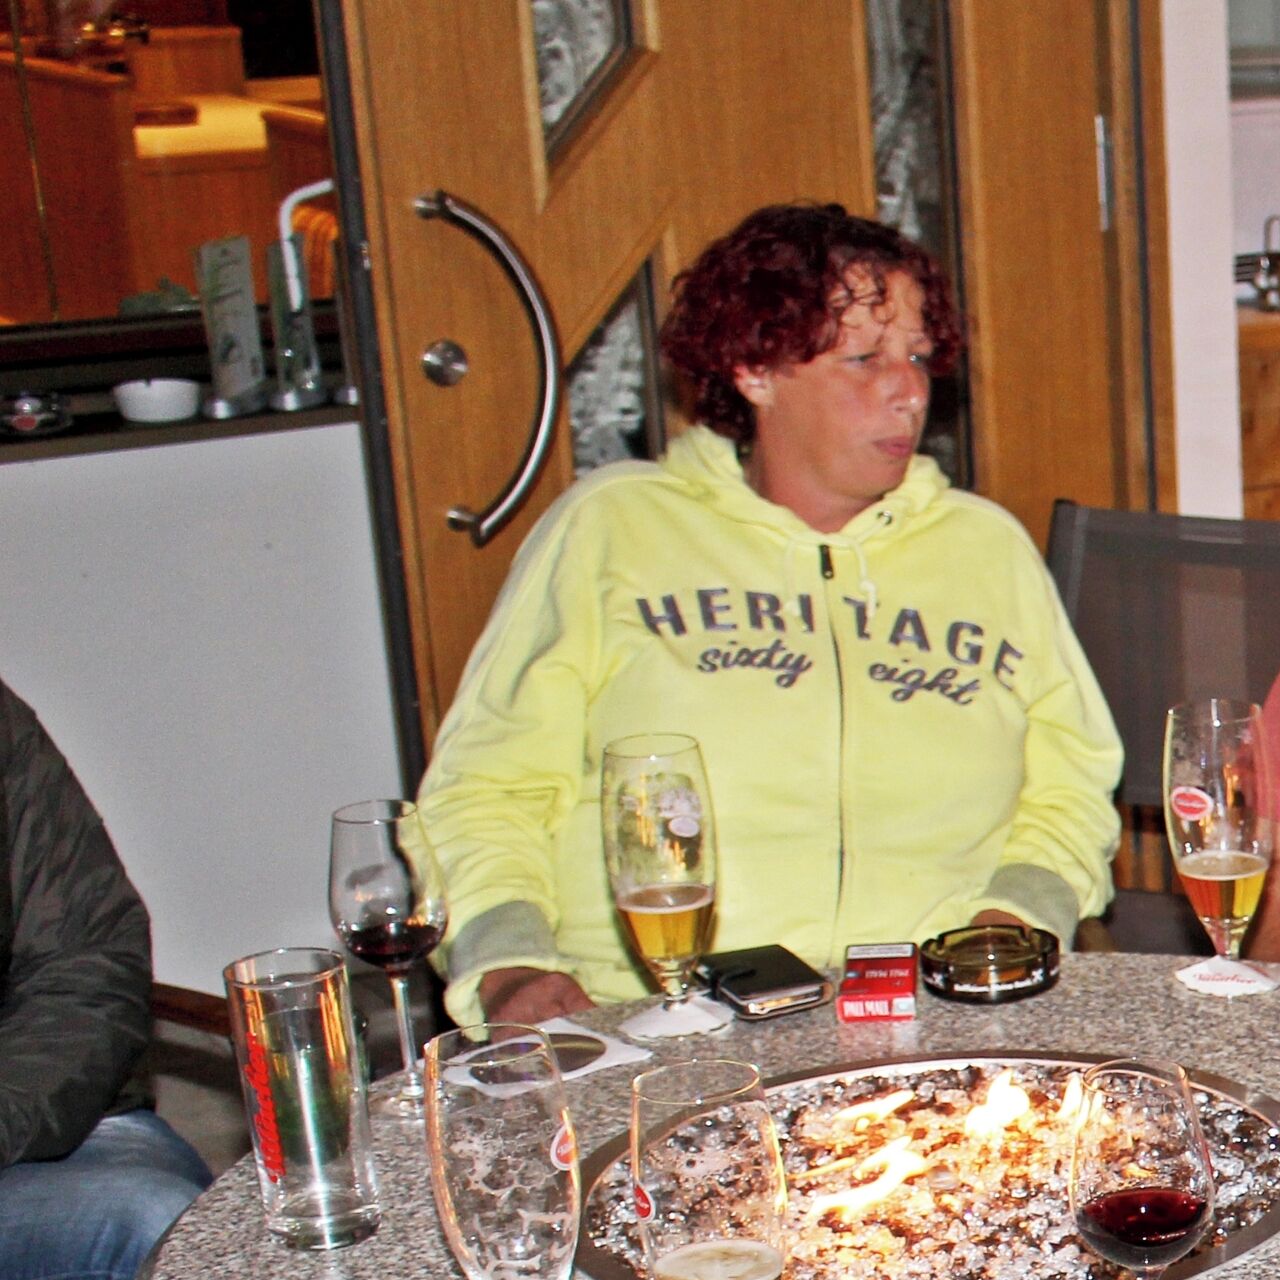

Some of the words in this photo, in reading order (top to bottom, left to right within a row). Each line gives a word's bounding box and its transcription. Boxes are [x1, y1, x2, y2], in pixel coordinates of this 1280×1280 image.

[635, 586, 1023, 694] HERITAGE
[697, 637, 813, 688] sixty
[868, 657, 981, 705] eight
